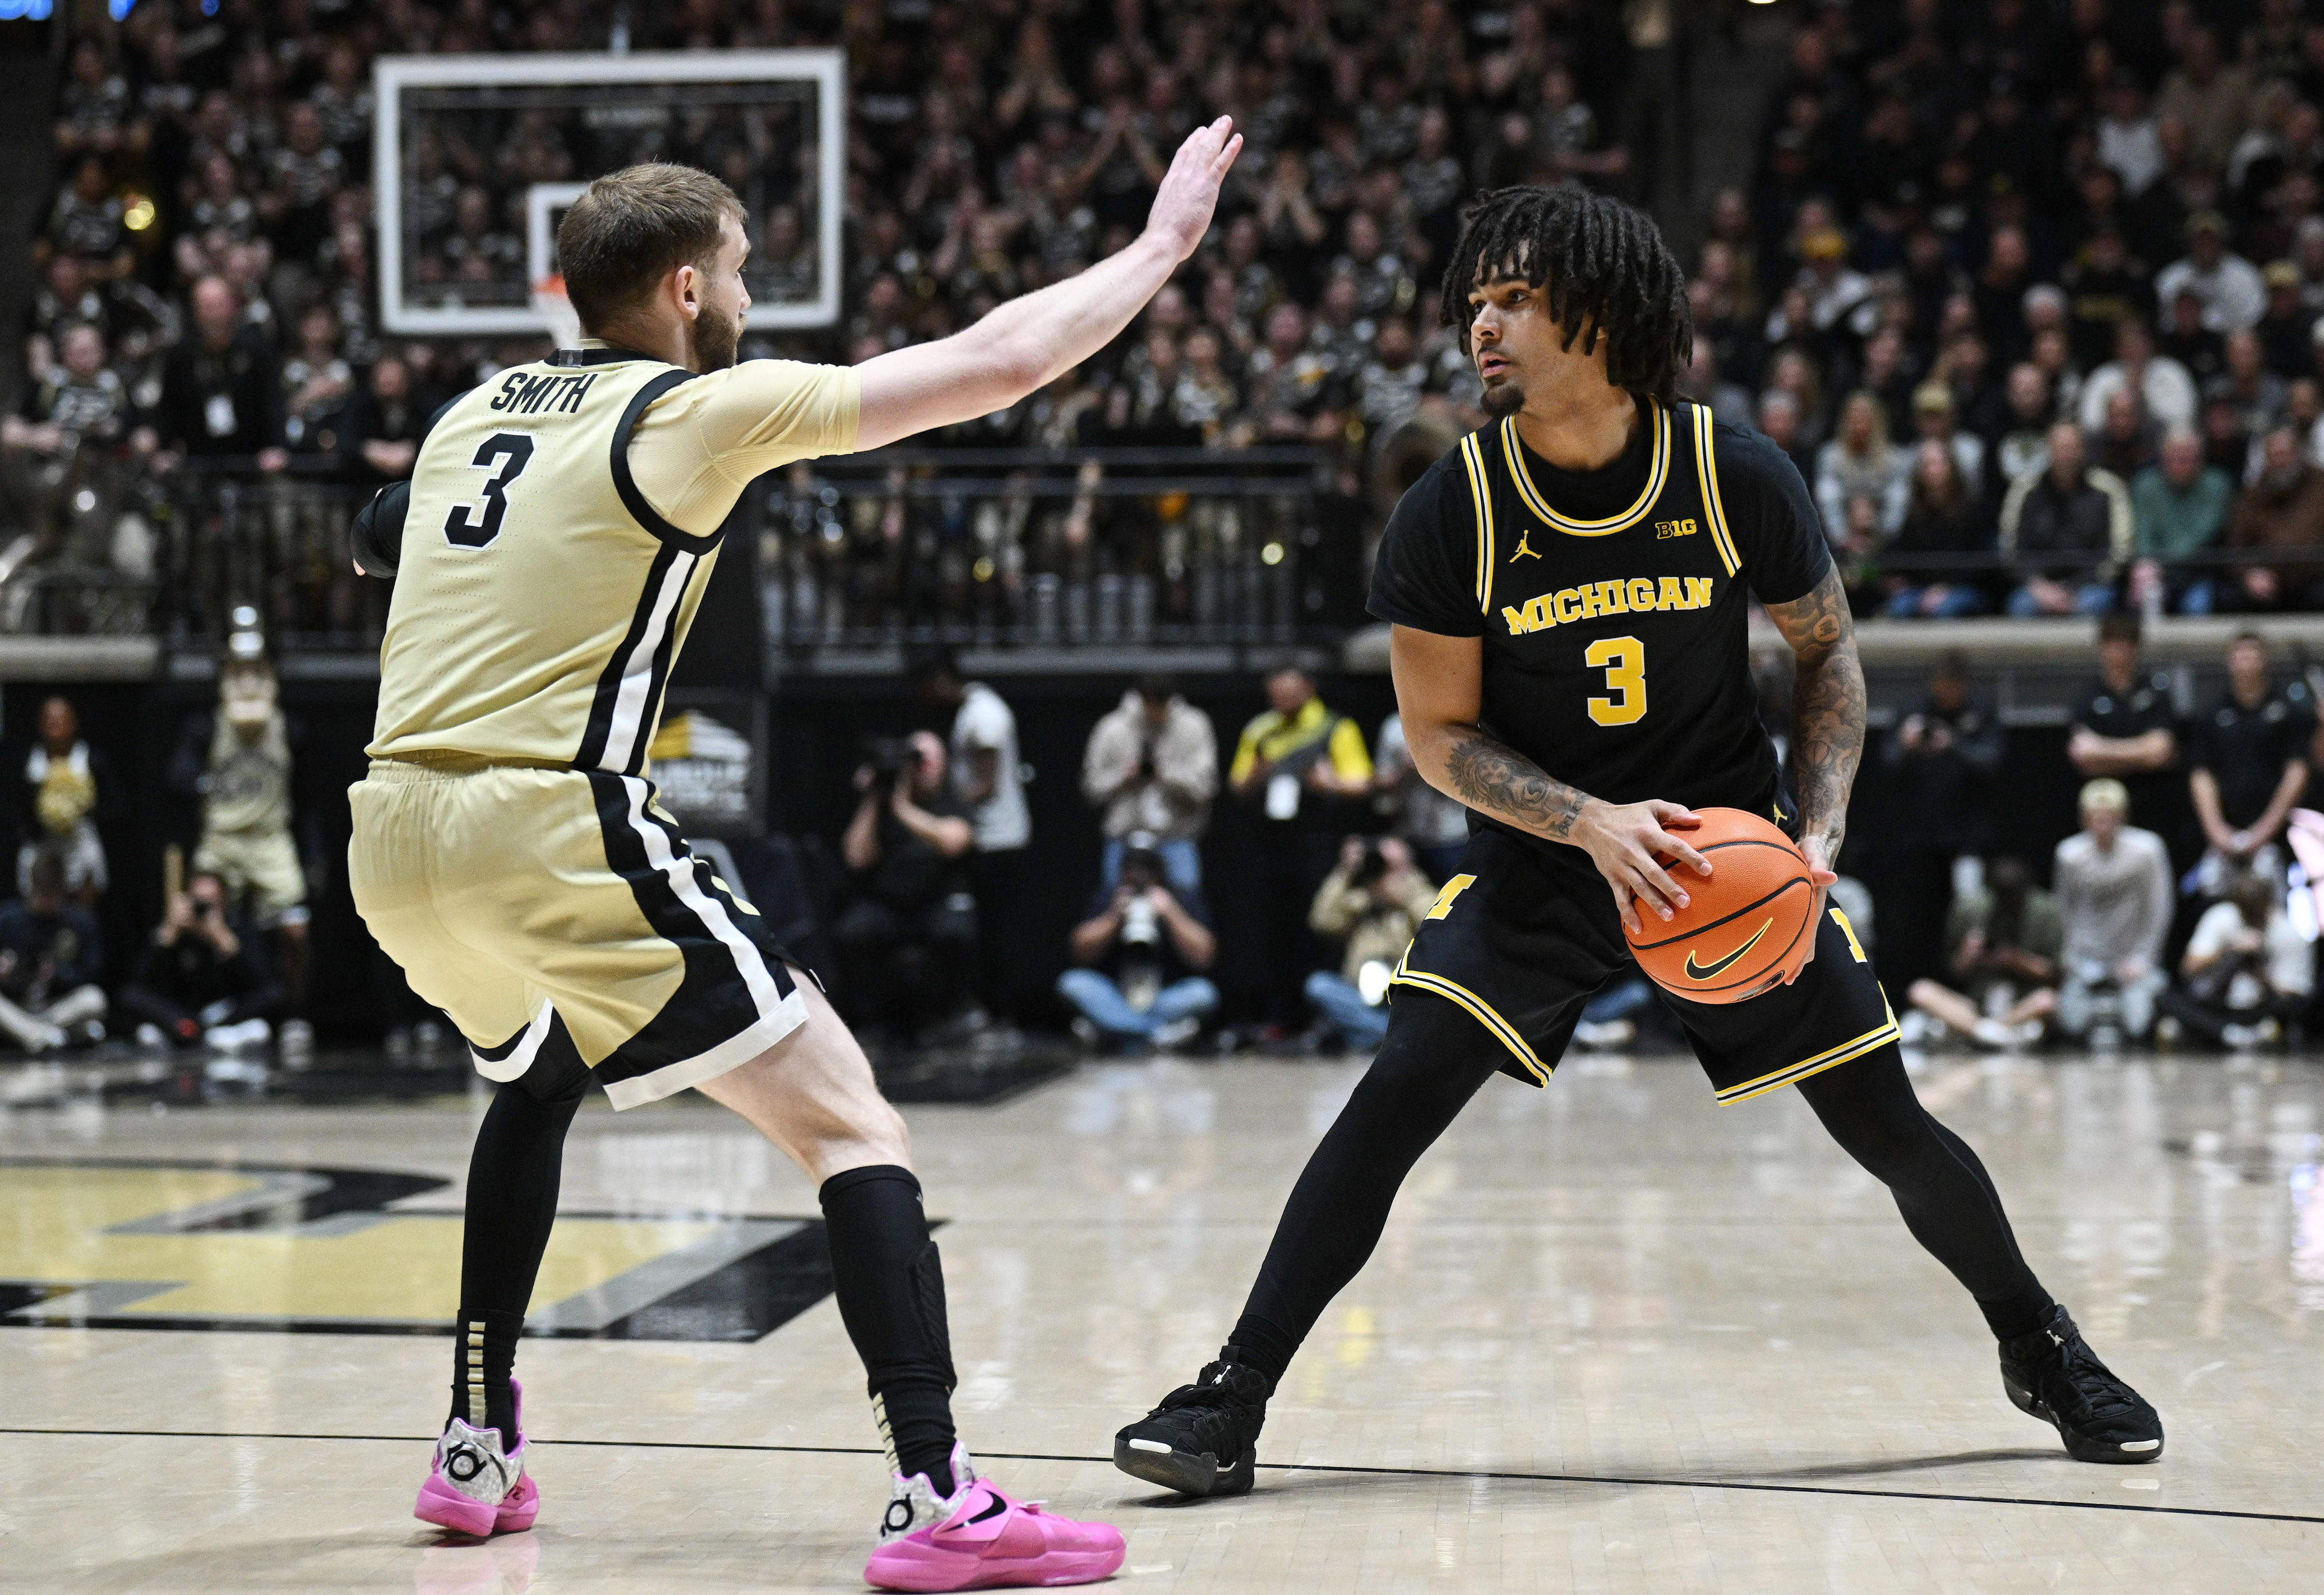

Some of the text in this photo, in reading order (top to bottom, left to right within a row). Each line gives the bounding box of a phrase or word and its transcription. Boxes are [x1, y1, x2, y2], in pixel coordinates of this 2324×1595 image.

[490, 372, 599, 414] SMITH
[441, 431, 535, 552] 3
[1501, 577, 1713, 635] MICHIGAN
[1584, 635, 1647, 727] 3
